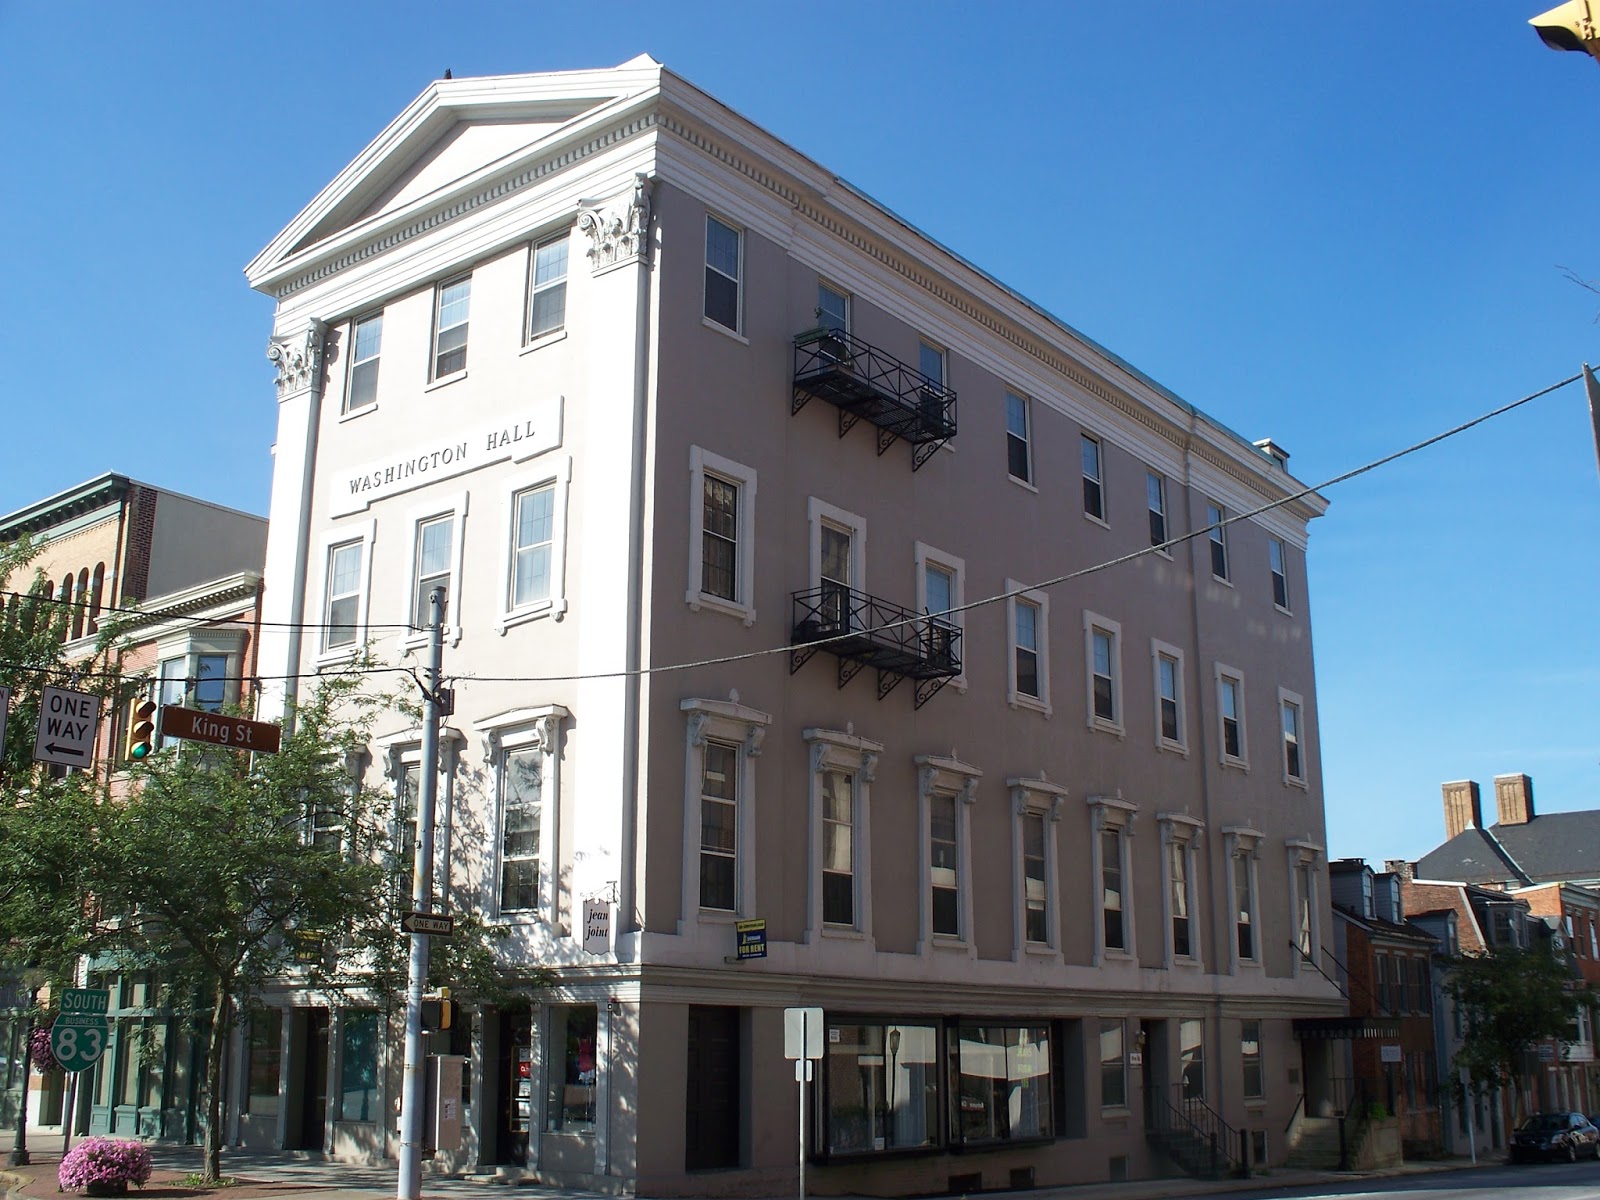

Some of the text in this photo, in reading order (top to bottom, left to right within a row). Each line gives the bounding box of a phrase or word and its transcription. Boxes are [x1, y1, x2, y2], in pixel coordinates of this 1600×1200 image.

[349, 421, 536, 494] WASHINGTON HALL
[50, 695, 91, 719] ONE
[47, 718, 89, 741] WAY
[192, 716, 253, 744] King St
[413, 919, 450, 931] ONE WAY
[586, 909, 609, 924] jean
[585, 927, 609, 941] joint
[739, 944, 765, 954] FOR RENT
[64, 992, 107, 1010] SOUTH
[65, 1017, 99, 1026] BUSINESS
[56, 1028, 102, 1061] 83
